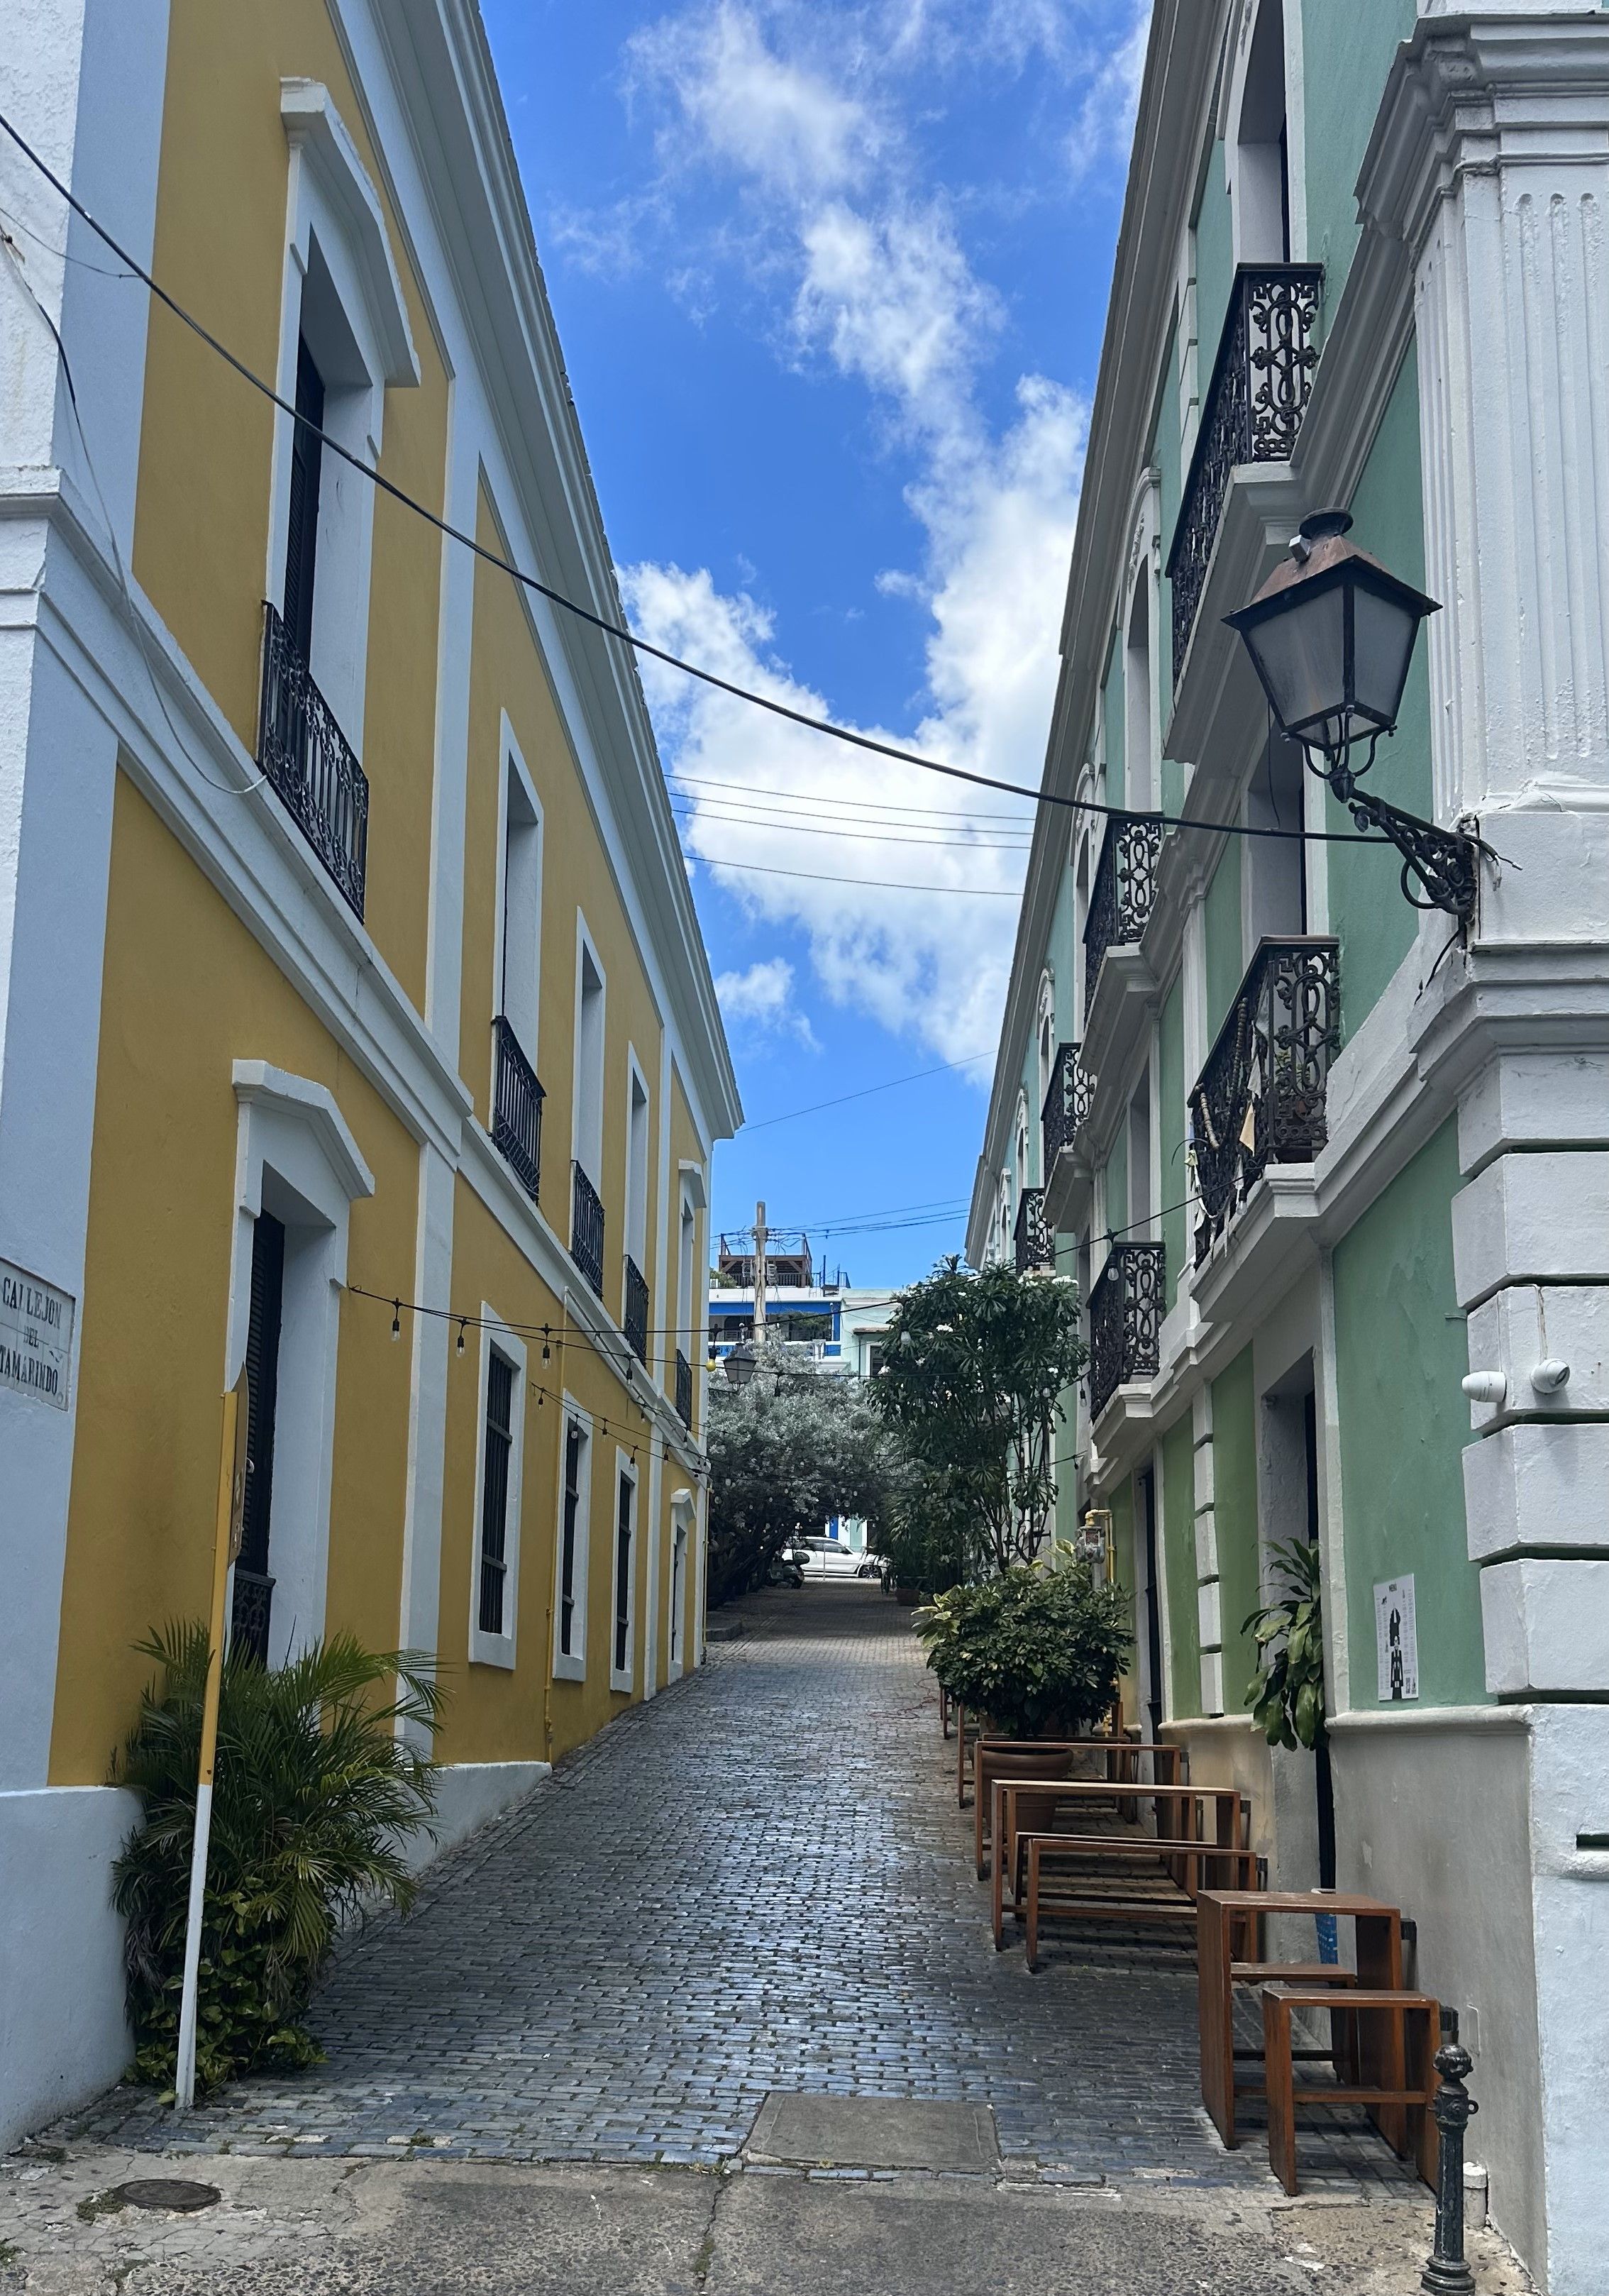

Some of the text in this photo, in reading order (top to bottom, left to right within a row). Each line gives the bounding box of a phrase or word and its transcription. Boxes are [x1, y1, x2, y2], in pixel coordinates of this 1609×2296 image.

[3, 1276, 62, 1330] CALLEJON
[23, 1325, 39, 1347] DEL
[0, 1345, 58, 1396] TAMARINDO
